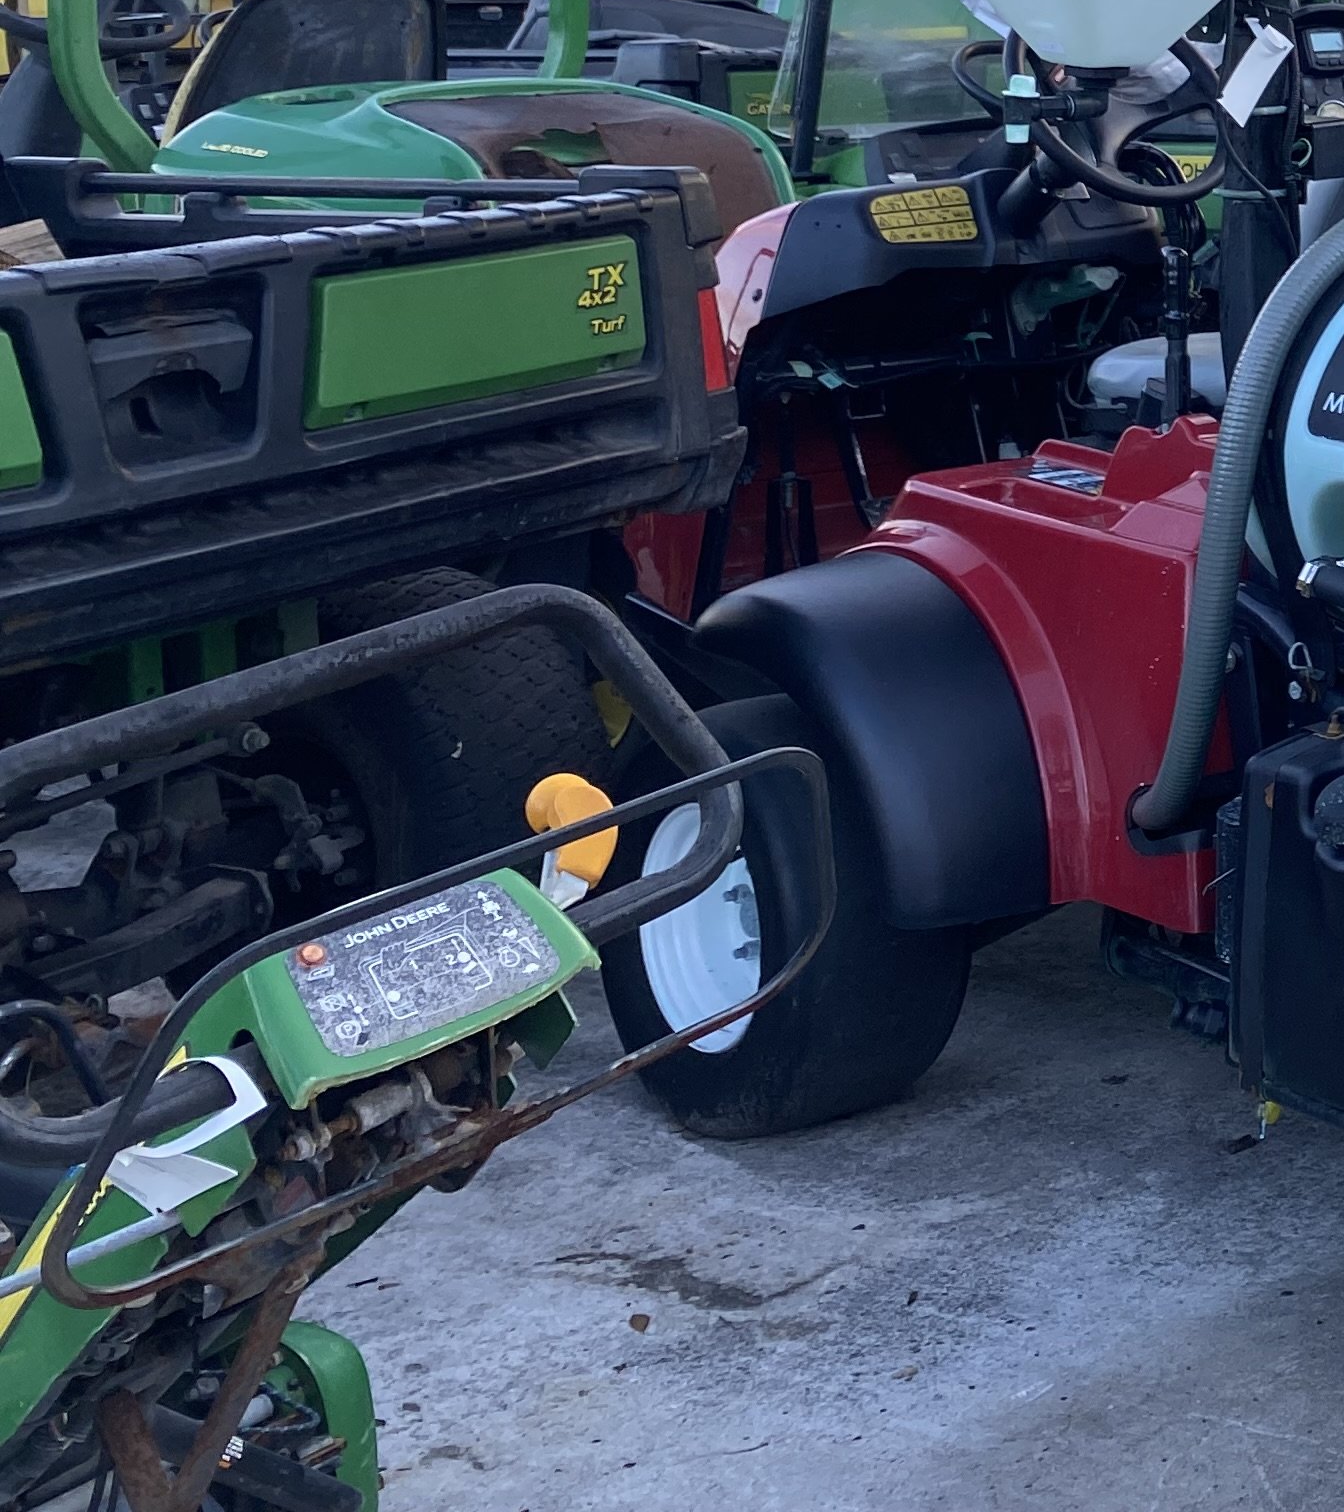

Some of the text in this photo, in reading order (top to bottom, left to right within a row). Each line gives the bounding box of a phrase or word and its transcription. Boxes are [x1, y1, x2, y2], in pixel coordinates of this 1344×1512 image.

[587, 262, 626, 290] TX
[577, 285, 617, 308] 4x2
[590, 315, 627, 335] Turf
[344, 902, 450, 949] JOHN DEERE
